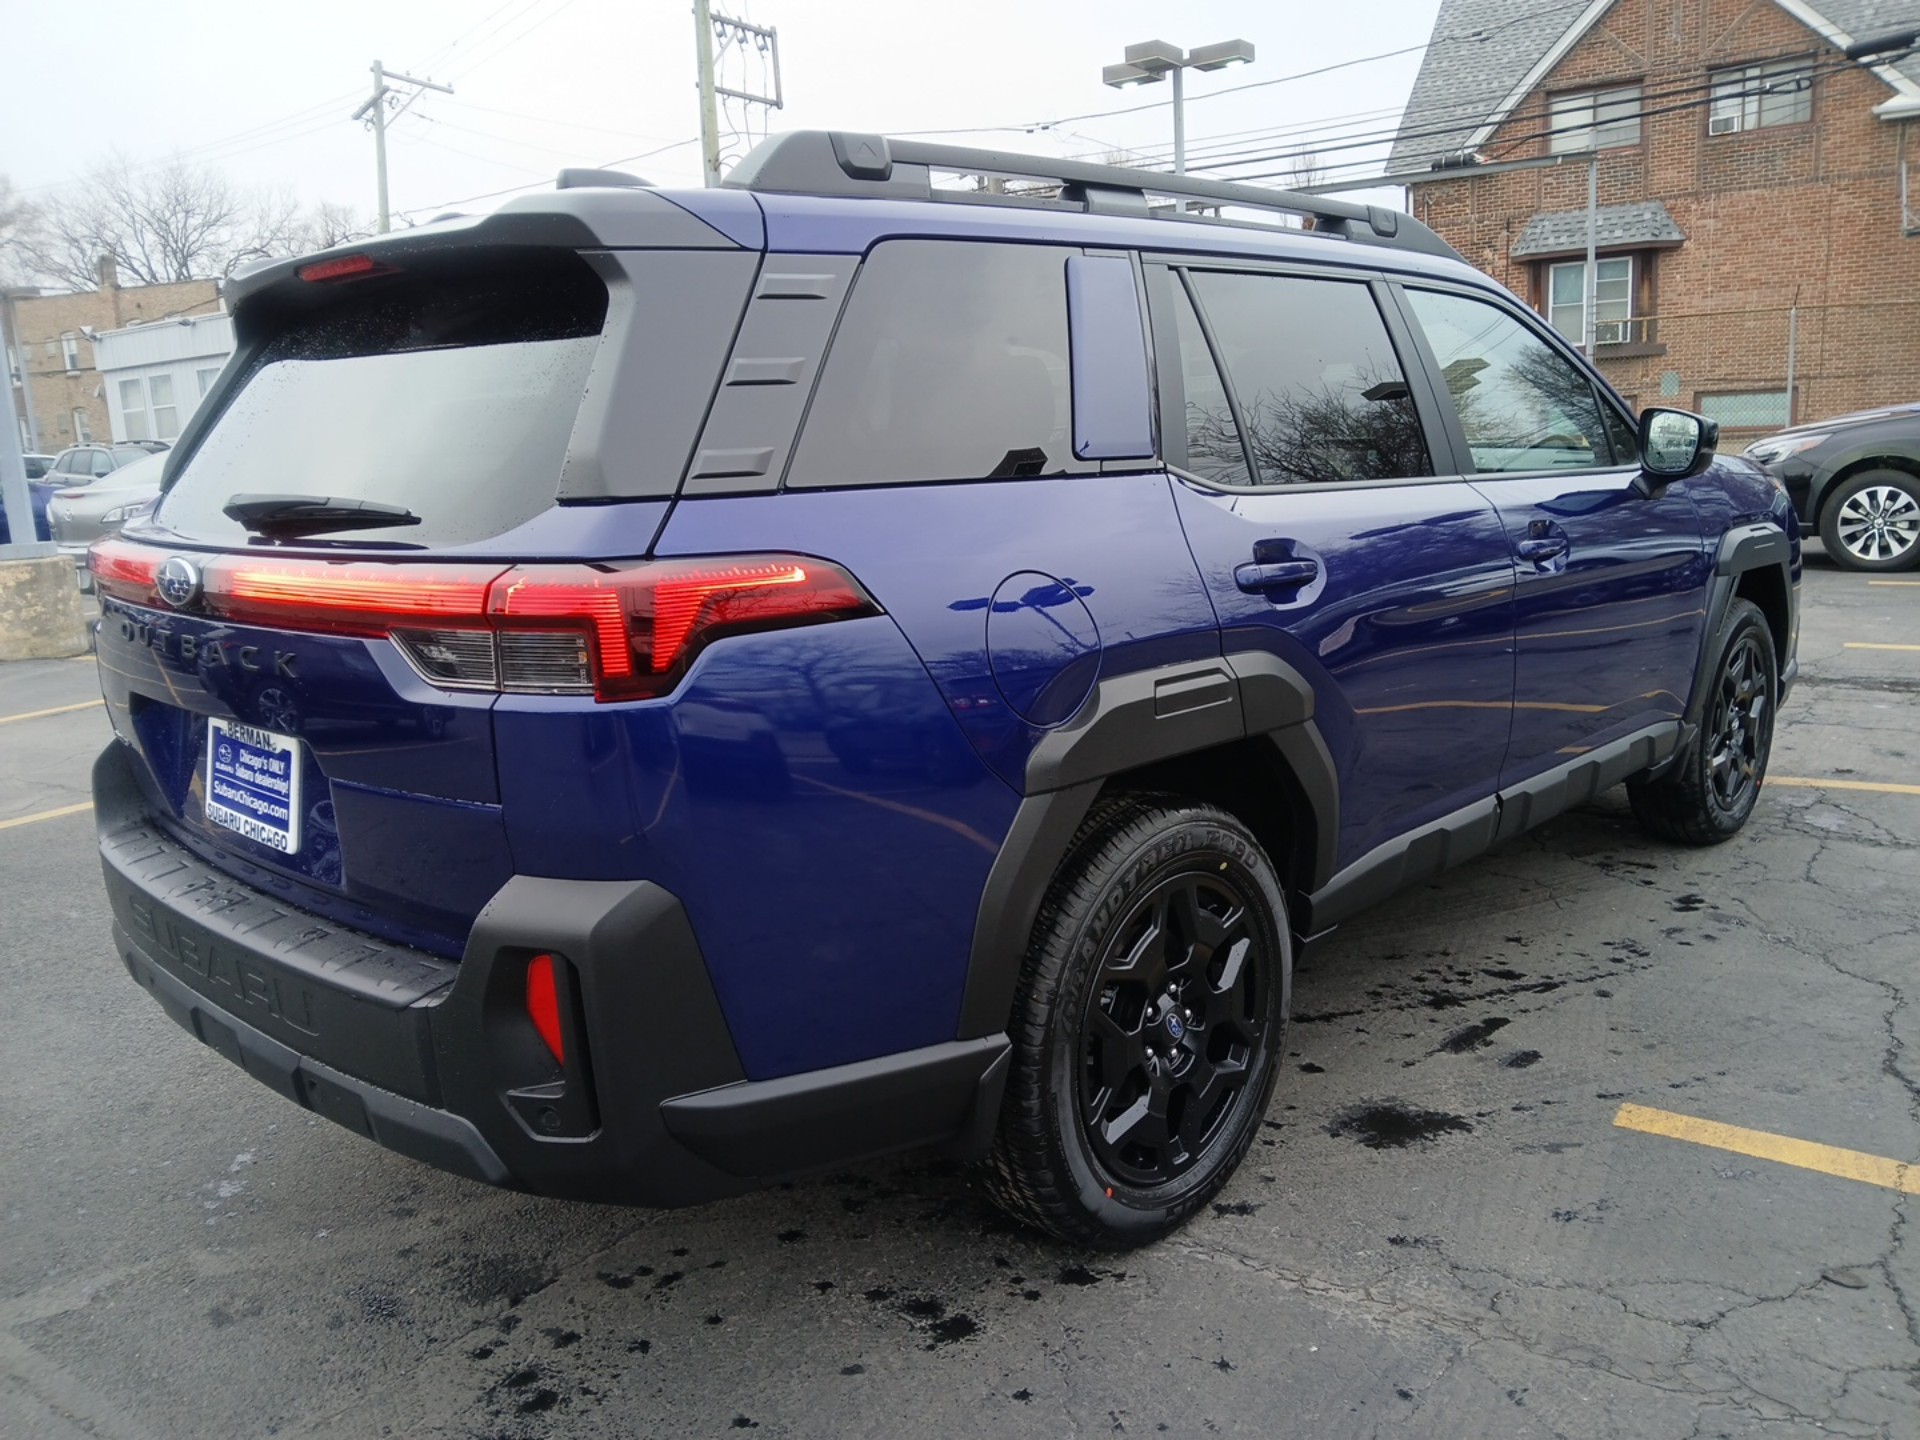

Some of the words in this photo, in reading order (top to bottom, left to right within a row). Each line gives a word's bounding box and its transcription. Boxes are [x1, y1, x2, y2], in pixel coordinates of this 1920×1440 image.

[121, 620, 297, 679] OUTBACK
[228, 722, 271, 750] BERMAN
[235, 763, 254, 782] Subaru
[239, 748, 268, 770] Chicago's
[268, 757, 285, 775] ONLY
[213, 780, 288, 821] SubaruChicago.com
[207, 803, 241, 831] SUBARU
[243, 819, 288, 851] CHICAGO
[129, 895, 320, 1037] SUBARU
